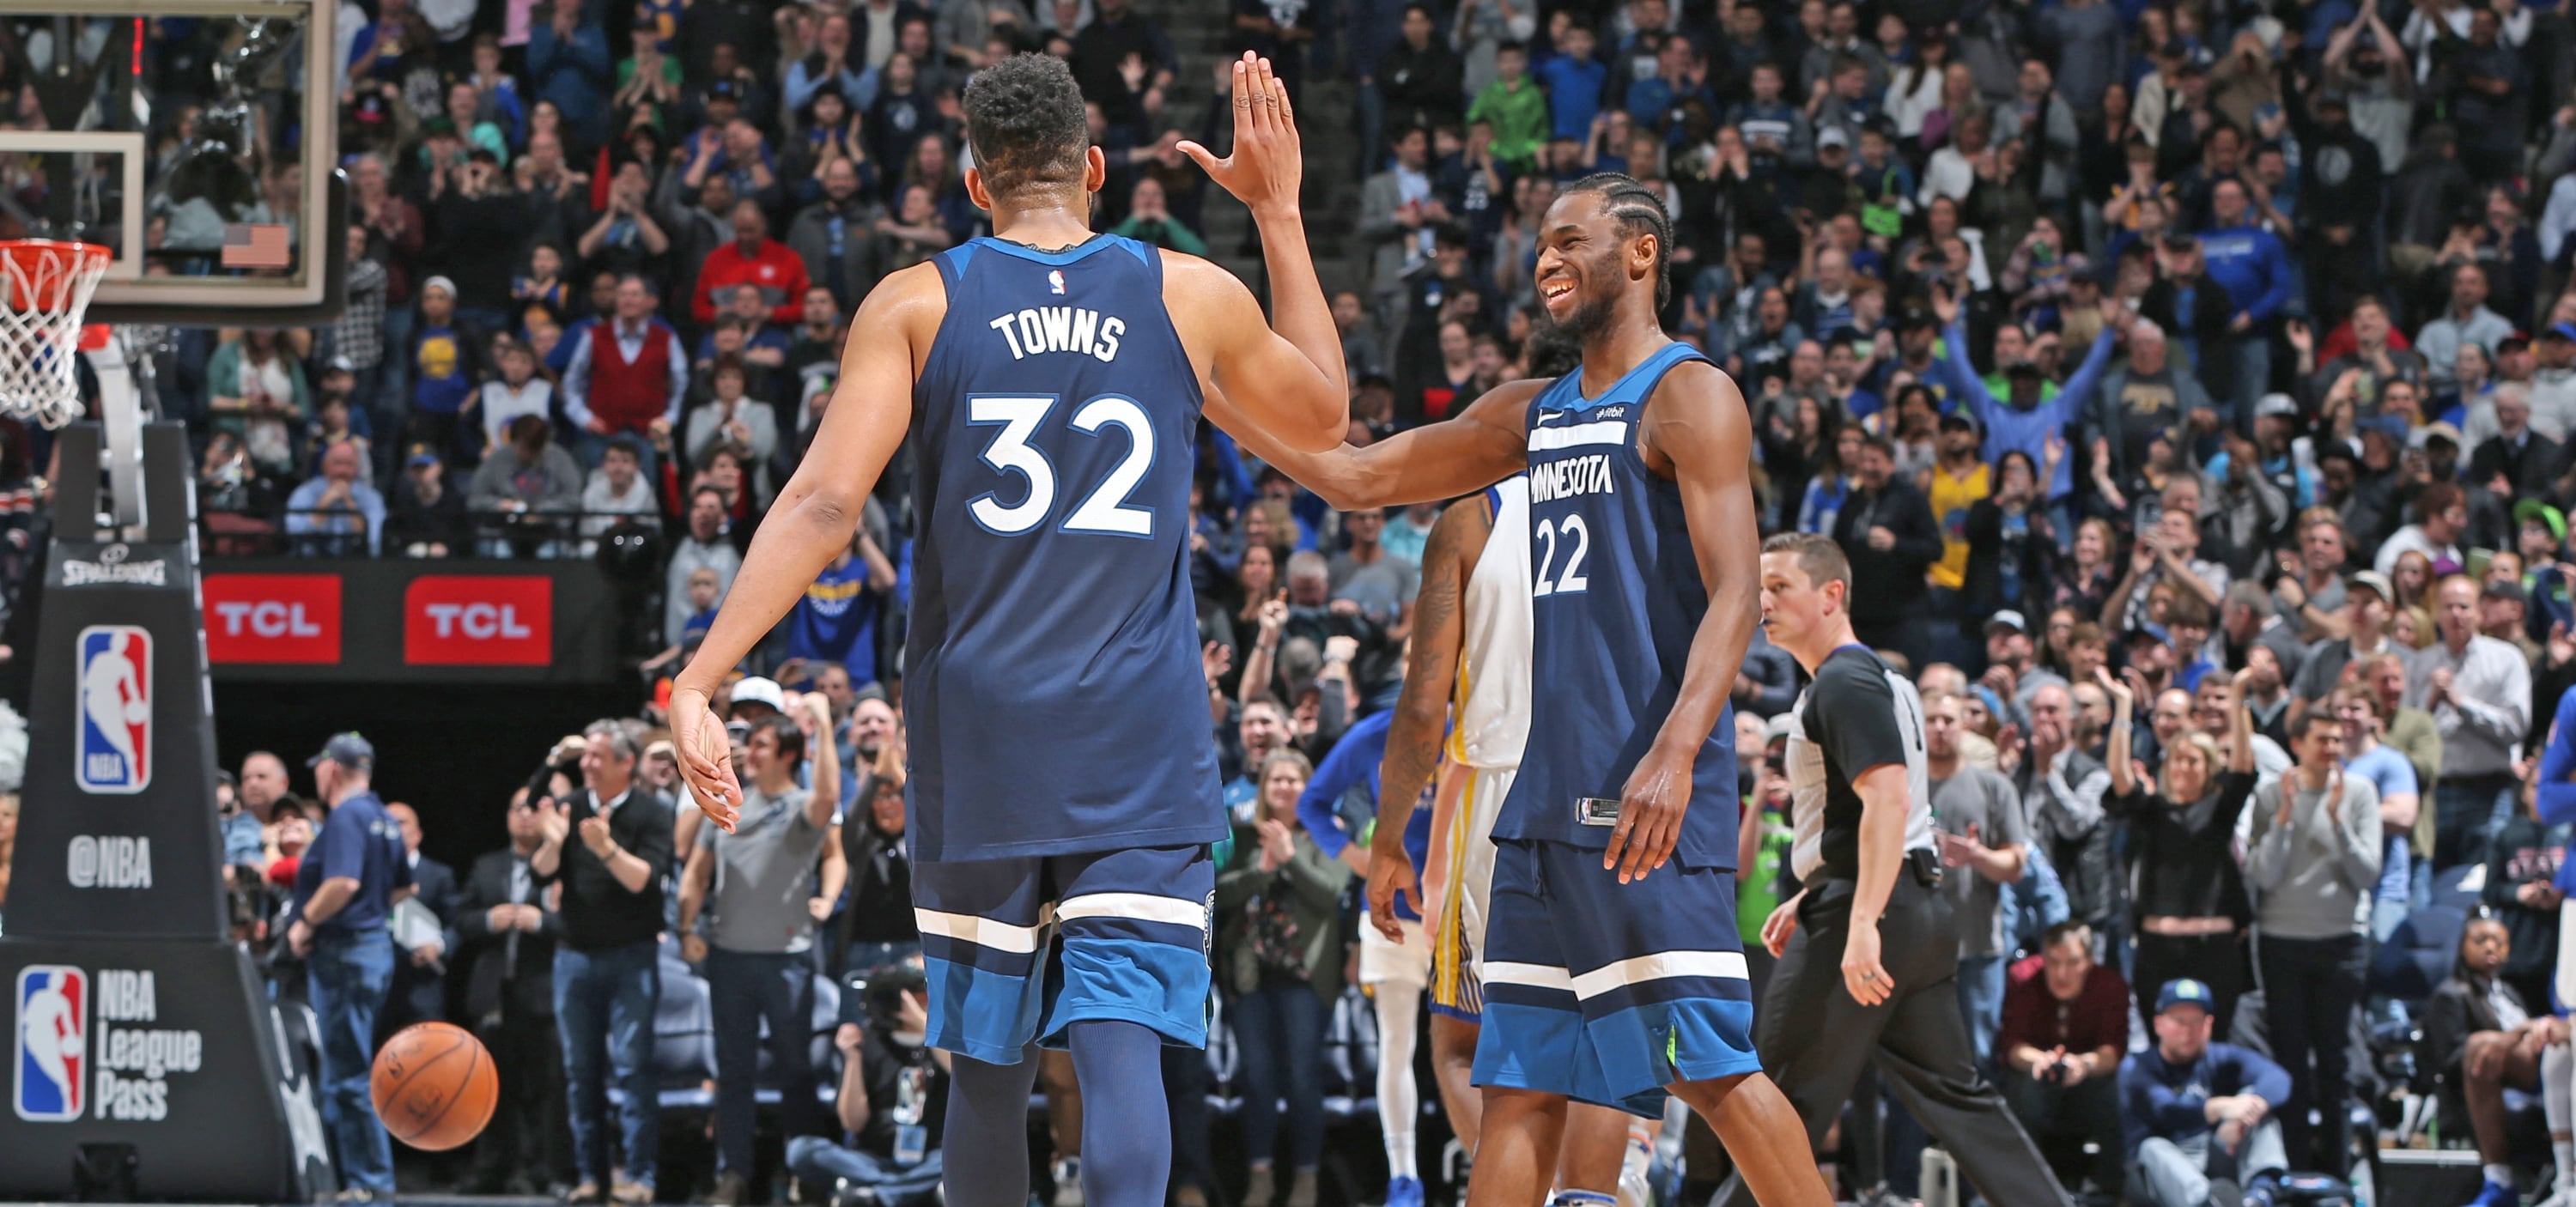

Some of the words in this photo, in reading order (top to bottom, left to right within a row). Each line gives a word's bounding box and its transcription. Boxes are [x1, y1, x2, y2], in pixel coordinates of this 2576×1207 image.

[989, 306, 1127, 363] TOWNS
[966, 393, 1157, 539] 32
[1529, 454, 1614, 504] MNNESOTA
[62, 559, 167, 586] SPALDING
[1534, 513, 1589, 597] 22
[216, 601, 320, 638] TCL
[426, 603, 531, 640] TCL
[87, 753, 124, 782] NBA
[67, 834, 153, 889] @NBA
[96, 969, 157, 1022] NBA
[95, 1020, 203, 1079] League
[94, 1070, 168, 1121] Pass
